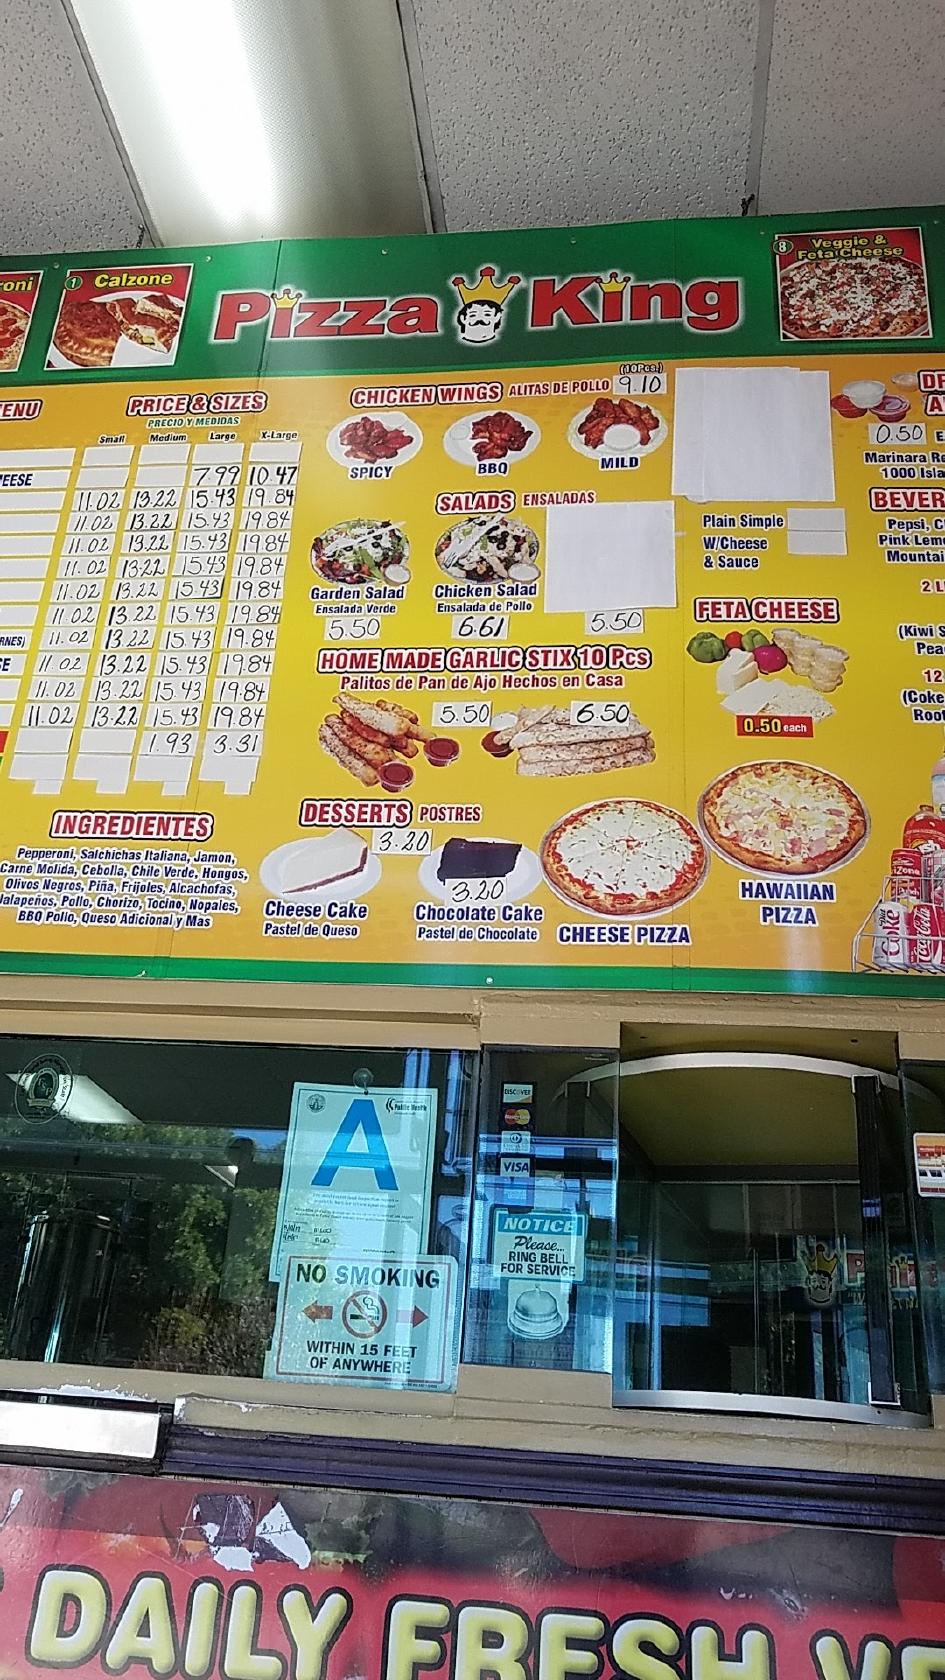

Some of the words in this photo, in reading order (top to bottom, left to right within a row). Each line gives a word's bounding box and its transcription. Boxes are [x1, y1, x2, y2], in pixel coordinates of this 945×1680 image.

[811, 235, 869, 250] Veggie
[874, 234, 887, 245] &
[797, 250, 835, 260] Feta
[839, 245, 904, 258] Cheese
[94, 272, 173, 289] Calzone
[214, 289, 438, 341] Pizza
[531, 274, 740, 331] King
[354, 388, 435, 406] CHICKEN
[439, 385, 501, 402] WINGS
[509, 383, 549, 397] ALITAS
[553, 382, 568, 394] DE
[572, 380, 610, 393] POLLO
[618, 375, 662, 394] 9.10
[129, 397, 186, 413] PRICE
[192, 396, 206, 411] &
[212, 394, 265, 410] SIZES
[148, 418, 184, 428] PRECIO
[195, 416, 240, 426] MEDIDAS
[100, 435, 126, 445] Small
[150, 434, 187, 443] Medium
[210, 432, 236, 442] Large
[261, 431, 298, 441] X-Large
[876, 423, 923, 444] 0.50
[599, 456, 640, 470] MILD
[864, 452, 927, 464] Marinara
[193, 465, 241, 486] 7.99
[249, 465, 298, 486] 10.47
[349, 466, 393, 480] SPICY
[477, 463, 509, 477] BBQ
[881, 467, 916, 479] 1000
[78, 491, 121, 512] 11.02
[133, 488, 177, 508] 13.22
[190, 487, 236, 509] 15.43
[248, 488, 294, 507] 19.84
[439, 493, 512, 512] SALADS
[522, 491, 596, 507] ENSALADAS
[703, 514, 736, 528] Plain
[740, 514, 784, 530] Simple
[887, 518, 930, 532] Pepsi,
[703, 536, 768, 551] W/Cheese
[879, 534, 910, 546] Pink
[703, 556, 714, 568] &
[718, 555, 759, 568] Sauce
[310, 586, 360, 600] Garden
[364, 585, 405, 600] Salad
[434, 584, 492, 599] Chicken
[496, 582, 538, 597] Salad
[922, 580, 931, 592] 2
[51, 606, 96, 625] 11.02
[108, 605, 157, 626] 13.22
[170, 604, 215, 624] 15.43
[231, 604, 281, 624] 19.84
[316, 604, 363, 614] Ensalada
[366, 604, 396, 614] Verde
[436, 602, 486, 613] Ensalada
[488, 602, 502, 612] de
[506, 601, 532, 612] Pollo
[699, 601, 748, 620] FETA
[754, 600, 836, 620] CHEESE
[328, 618, 380, 641] 5.50
[458, 615, 505, 637] 6.61
[589, 610, 643, 633] 5.50
[898, 625, 934, 640] (Kiwi
[320, 650, 380, 672] HOME
[386, 650, 443, 670] MADE
[448, 649, 524, 670] GARLIC
[528, 648, 574, 668] STIX
[579, 648, 606, 668] 10
[612, 648, 650, 668] Pcs
[340, 676, 391, 691] Palitos
[395, 676, 413, 690] de
[418, 676, 446, 690] Pan
[450, 675, 469, 690] de
[472, 675, 498, 692] Ajo
[502, 674, 558, 689] Hechos
[562, 676, 581, 688] en
[586, 674, 624, 688] Casa
[924, 670, 943, 683] 12
[28, 705, 74, 727] 11.02
[91, 705, 138, 727] 13.22
[152, 706, 199, 728] 15.43
[213, 705, 265, 728] 19.84
[439, 704, 491, 725] 5.50
[575, 703, 630, 724] 6.50
[743, 717, 782, 734] 0.50
[783, 723, 808, 733] each
[149, 732, 192, 754] 1.93
[213, 733, 259, 754] 3.31
[304, 802, 410, 824] DESSERTS
[420, 806, 482, 822] POSTRES
[54, 814, 210, 838] INGREDIENTES
[378, 830, 431, 852] 3.20
[17, 848, 77, 862] Pepperoni,
[80, 848, 142, 861] Salchichas
[144, 850, 191, 864] Italiana,
[193, 850, 236, 866] Jamon,
[0, 862, 33, 874] Carne
[36, 862, 78, 876] Molida,
[82, 864, 128, 878] Cebolla,
[132, 865, 160, 878] Chile
[162, 866, 199, 880] Verde,
[202, 868, 248, 882] Hongos,
[5, 878, 39, 890] Olivos
[42, 879, 85, 893] Negros,
[88, 879, 118, 894] Piña,
[121, 881, 166, 895] Frijoles,
[168, 882, 237, 897] Alcachofas,
[452, 879, 505, 904] 3.20
[740, 882, 836, 901] HAWAIIAN
[61, 895, 94, 909] Pollo,
[96, 896, 143, 910] Chorizo,
[147, 898, 186, 912] Tocino,
[189, 899, 240, 914] Nopales,
[264, 900, 322, 918] Cheese
[327, 902, 368, 919] Cake
[416, 904, 496, 922] Chocolate
[501, 904, 544, 922] Cake
[18, 910, 42, 922] BBQ
[46, 910, 78, 924] Pollo,
[81, 912, 117, 926] Queso
[120, 912, 173, 926] Adicional
[186, 914, 211, 928] Mas
[762, 906, 817, 926] PIZZA
[264, 923, 302, 936] Pastel
[304, 924, 319, 936] de
[322, 924, 358, 938] Queso
[418, 927, 456, 940] Pastel
[458, 928, 474, 940] de
[476, 927, 538, 941] Chocolate
[559, 926, 631, 944] CHEESE
[637, 927, 690, 944] PIZZA
[311, 1098, 399, 1191] A
[504, 1162, 529, 1173] VISA
[504, 1218, 577, 1234] NOTICE
[508, 1251, 537, 1264] RING
[540, 1252, 569, 1265] BELL
[296, 1263, 327, 1284] NO
[334, 1265, 440, 1289] SMOKING
[500, 1262, 523, 1274] FOR
[526, 1264, 576, 1277] SERVICE
[306, 1340, 355, 1356] WITHIN
[360, 1344, 379, 1356] 15
[384, 1344, 418, 1359] FEET
[310, 1356, 328, 1370] OF
[332, 1358, 412, 1375] ANYWHERE
[29, 1569, 349, 1680] DAILY
[386, 1599, 770, 1680] FRESH
